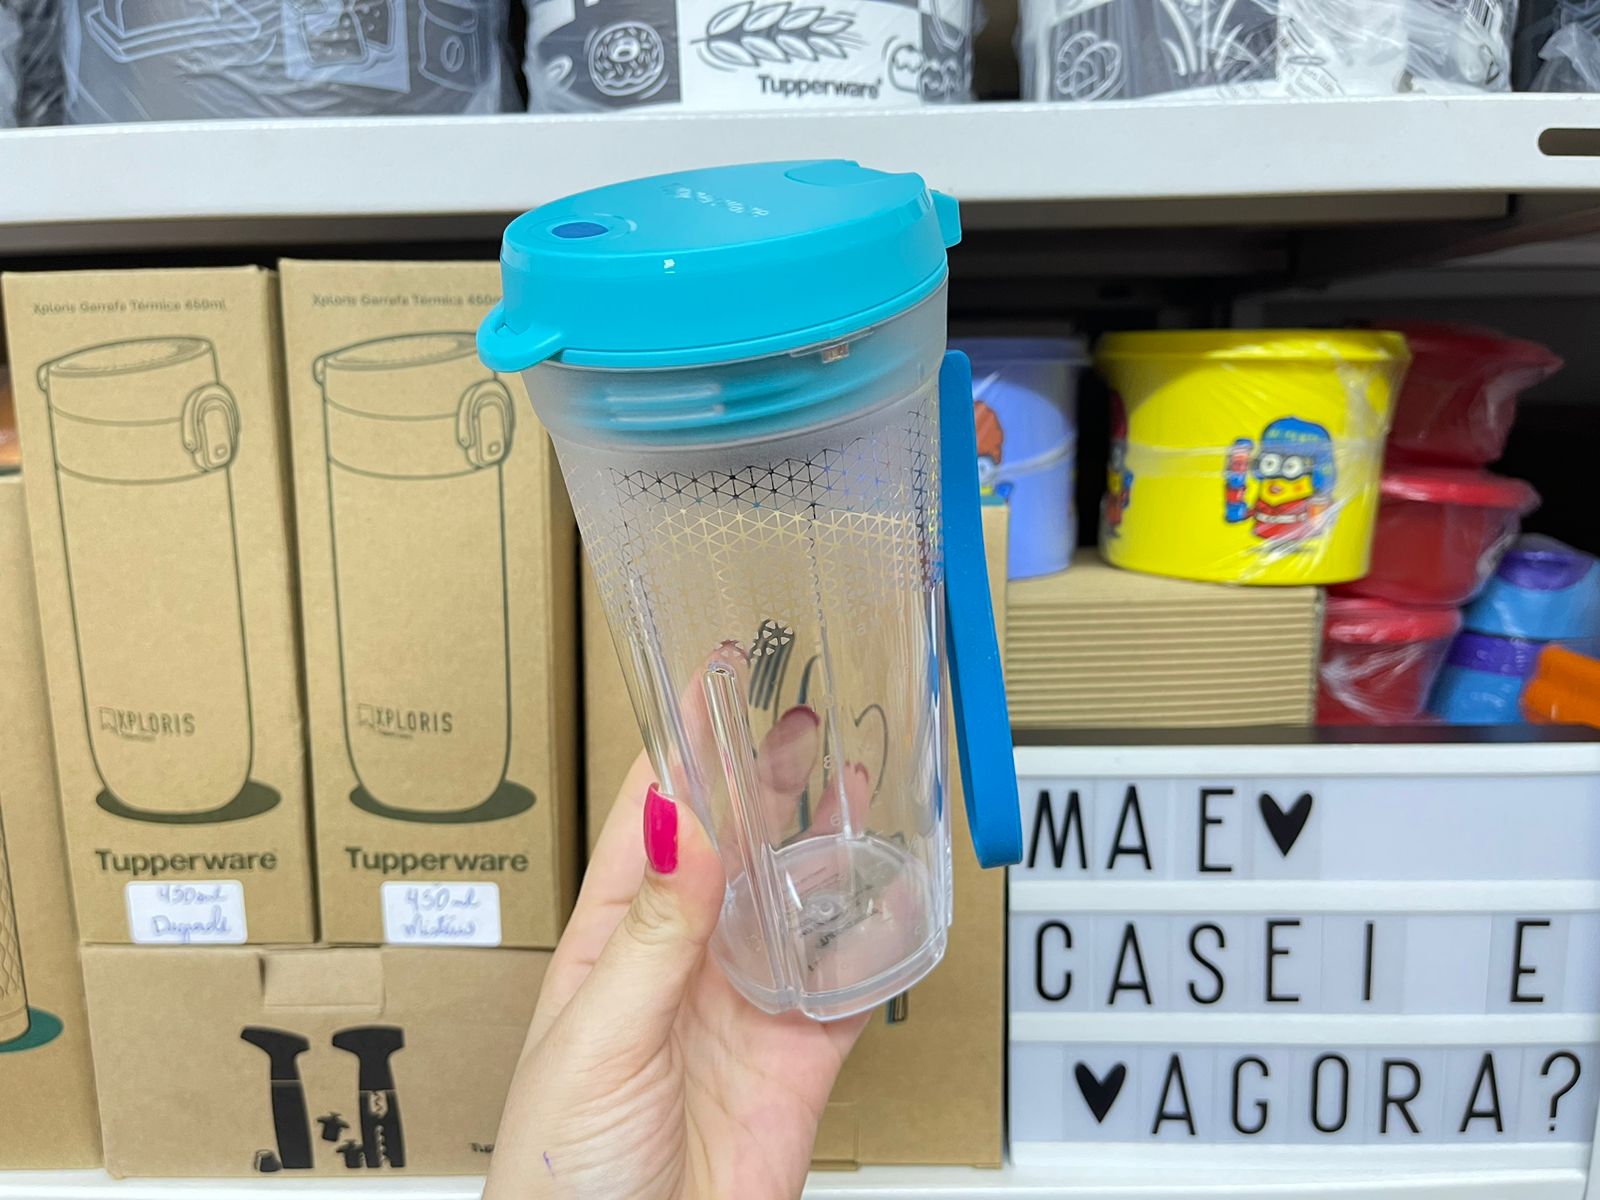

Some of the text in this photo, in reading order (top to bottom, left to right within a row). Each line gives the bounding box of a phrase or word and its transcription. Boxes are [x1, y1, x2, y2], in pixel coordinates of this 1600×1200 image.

[758, 74, 880, 98] Tupperware
[117, 708, 195, 736] XPLORIS
[376, 706, 453, 734] XPLORIS
[1027, 783, 1234, 874] MAE
[95, 848, 277, 876] Tupperware
[345, 846, 529, 875] Tupperware
[1035, 919, 1551, 1005] CASEI E
[1150, 1050, 1582, 1136] AGORA?
